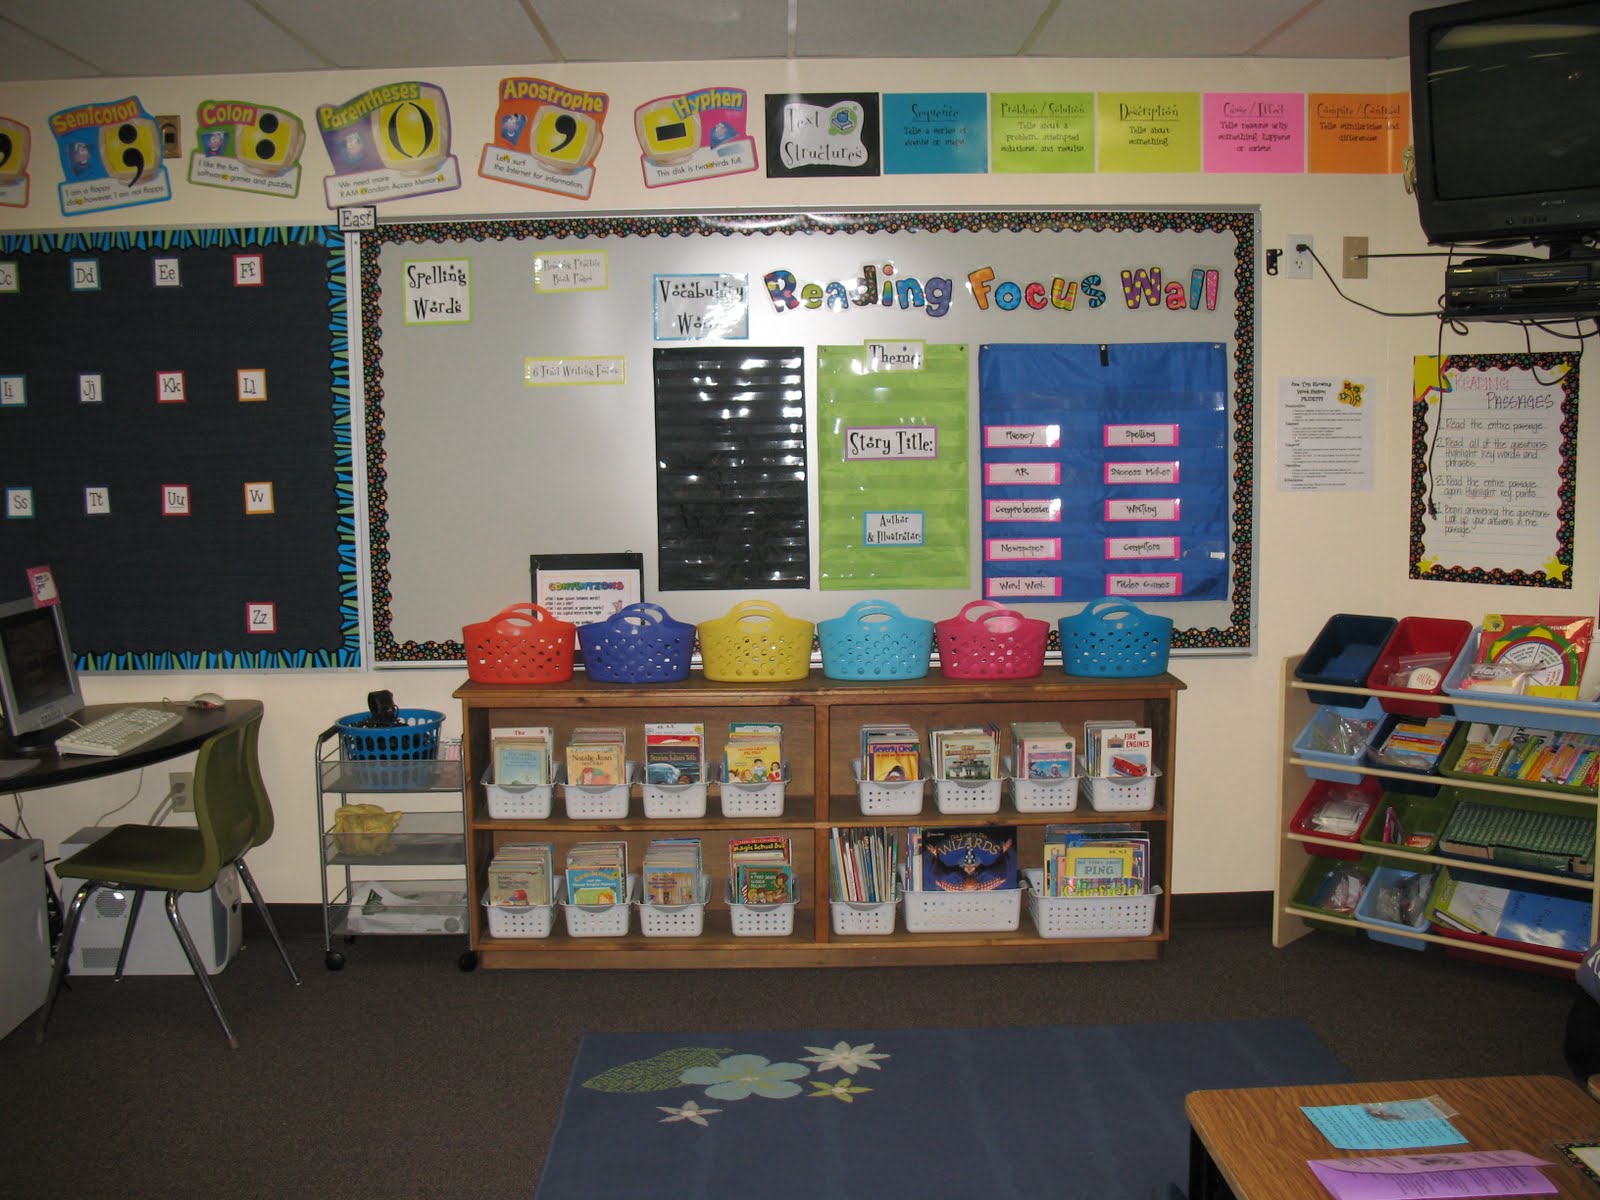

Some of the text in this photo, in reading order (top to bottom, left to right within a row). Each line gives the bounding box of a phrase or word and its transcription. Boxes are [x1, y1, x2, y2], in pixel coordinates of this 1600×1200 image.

[503, 79, 604, 112] Apostrophe
[319, 83, 418, 129] Parentheses
[673, 89, 743, 119] Hyphen
[1000, 102, 1085, 118] Problem Solution
[1317, 103, 1354, 119] Compare
[52, 100, 137, 133] Semicolon
[203, 102, 254, 124] Colon
[911, 103, 959, 123] Sequence
[1120, 103, 1179, 121] Description
[787, 108, 820, 132] Text
[784, 141, 863, 166] Structures
[513, 158, 526, 166] surf
[494, 163, 504, 172] the
[506, 166, 531, 177] Internet
[533, 170, 543, 180] for
[656, 164, 693, 177] This disk is
[230, 175, 251, 183] games
[253, 176, 266, 185] and
[353, 178, 371, 186] need
[340, 190, 359, 198] RAM
[341, 209, 373, 228] East
[0, 270, 12, 285] Cc
[76, 267, 95, 283] Dd
[159, 264, 176, 281] Ee
[240, 262, 256, 279] Ff
[407, 264, 467, 289] Spelling
[764, 263, 1220, 317] Reading Focus Wall
[413, 296, 462, 320] Words
[532, 366, 539, 377] 6
[562, 365, 594, 377] Writing
[83, 380, 96, 400] Jj
[162, 378, 181, 394] Kk
[243, 378, 256, 395] Ll
[1454, 374, 1510, 391] READING
[1486, 391, 1554, 410] PASSAGES
[1445, 418, 1510, 430] Read the entire
[850, 431, 933, 455] Story Title:
[1006, 431, 1035, 444] Fluency
[1125, 429, 1156, 443] Spelling
[1445, 437, 1507, 449] Read all of the
[1497, 450, 1520, 459] words
[1522, 449, 1538, 459] and
[1015, 468, 1029, 476] AR
[1111, 467, 1171, 477] Success Maker
[1445, 476, 1505, 488] Read the entire
[14, 495, 28, 509] Ss
[89, 492, 104, 507] Tt
[167, 491, 185, 506] Uu
[1126, 504, 1157, 517] Writing
[1444, 504, 1462, 515] Begin
[1502, 506, 1515, 516] the
[880, 514, 909, 527] Author
[1444, 516, 1456, 524] Look
[1460, 517, 1469, 525] up
[1472, 518, 1484, 529] your
[1525, 518, 1537, 527] the
[1001, 544, 1045, 556] Newspaper
[1123, 542, 1161, 555] Computers
[549, 581, 624, 592] CONVENTIONS
[999, 579, 1045, 590] Word Work
[1116, 579, 1170, 589] Folder Games
[253, 609, 267, 625] Zz
[873, 745, 897, 753] Beverly
[733, 844, 753, 853] Magic
[754, 843, 774, 851] School
[938, 837, 1001, 856] WIZARDS
[1084, 865, 1114, 875] PING
[1062, 882, 1139, 897] Garfield
